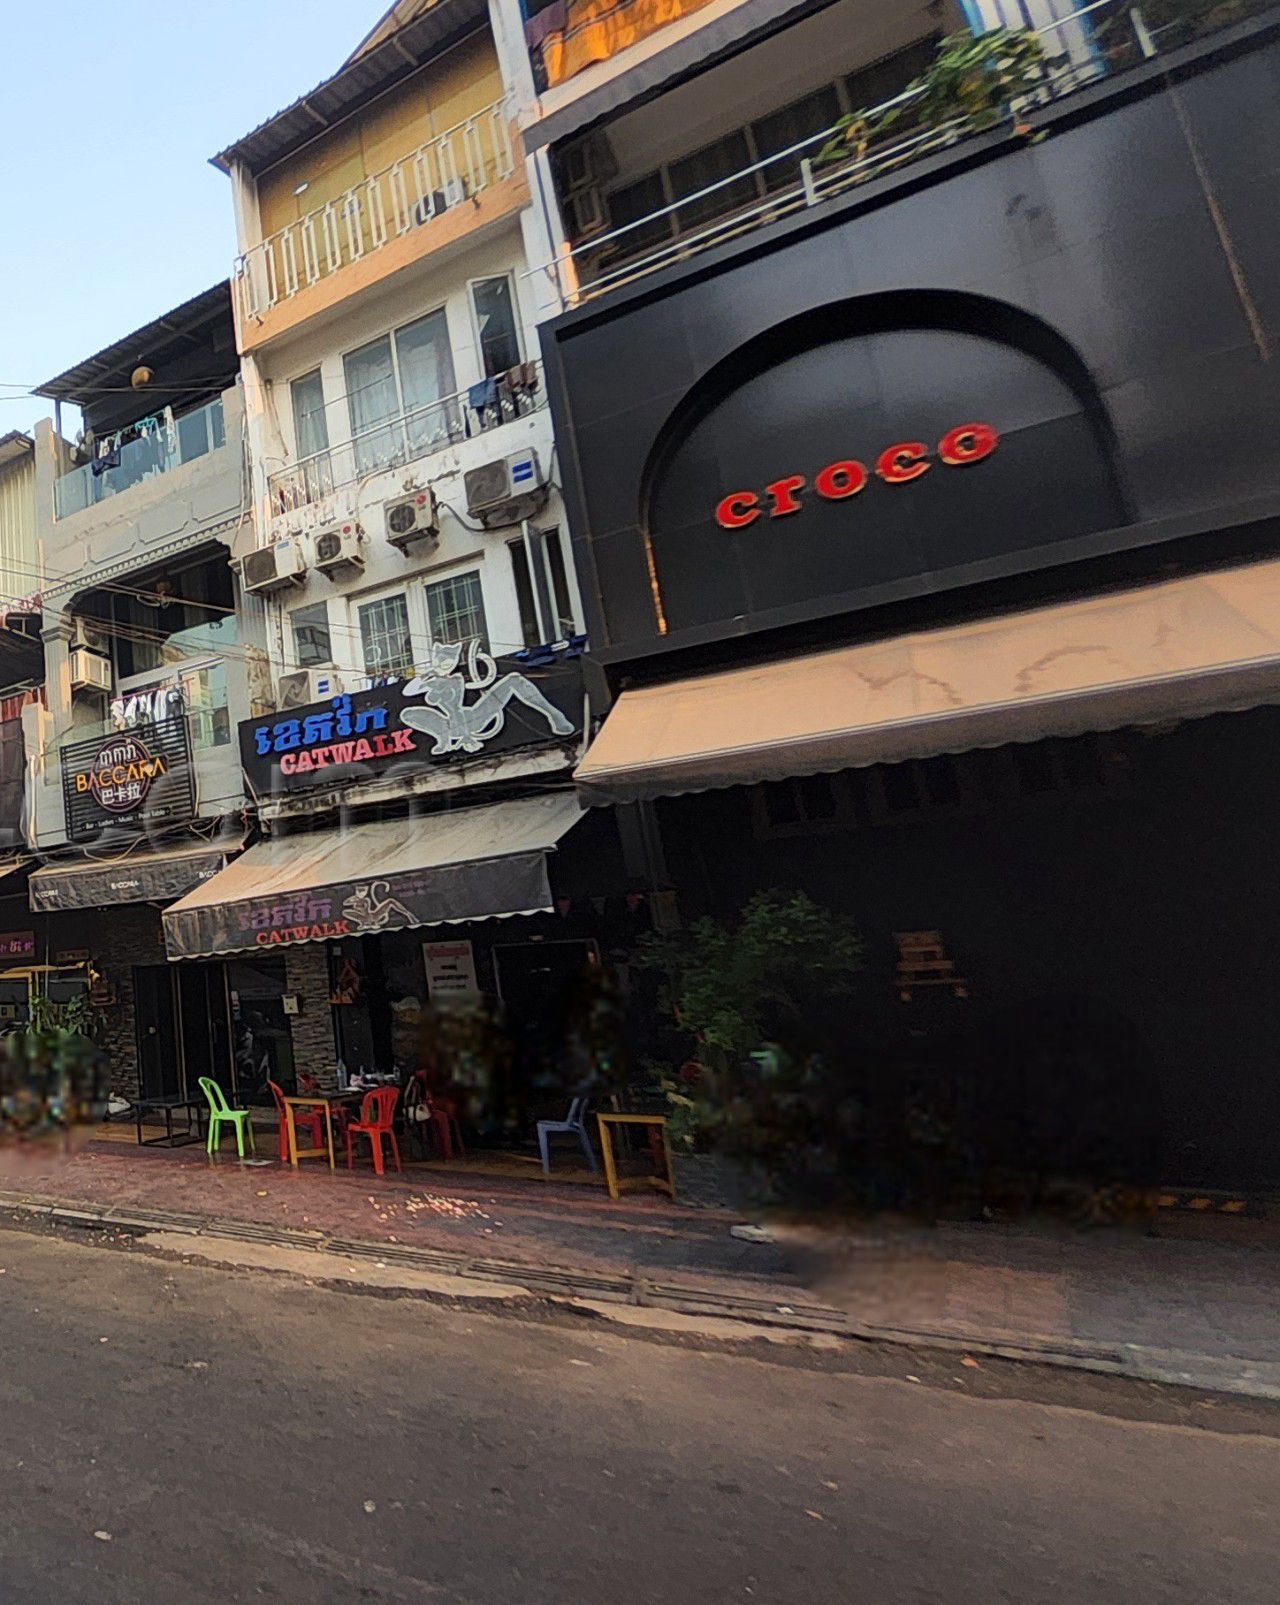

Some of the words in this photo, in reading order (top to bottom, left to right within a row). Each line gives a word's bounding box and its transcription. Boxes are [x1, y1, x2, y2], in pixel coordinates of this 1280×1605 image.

[714, 421, 1000, 529] croco
[280, 728, 417, 775] CATWALK
[76, 757, 166, 792] BACCARA
[101, 781, 142, 805] 巴卡拉
[255, 919, 351, 946] CATWALK
